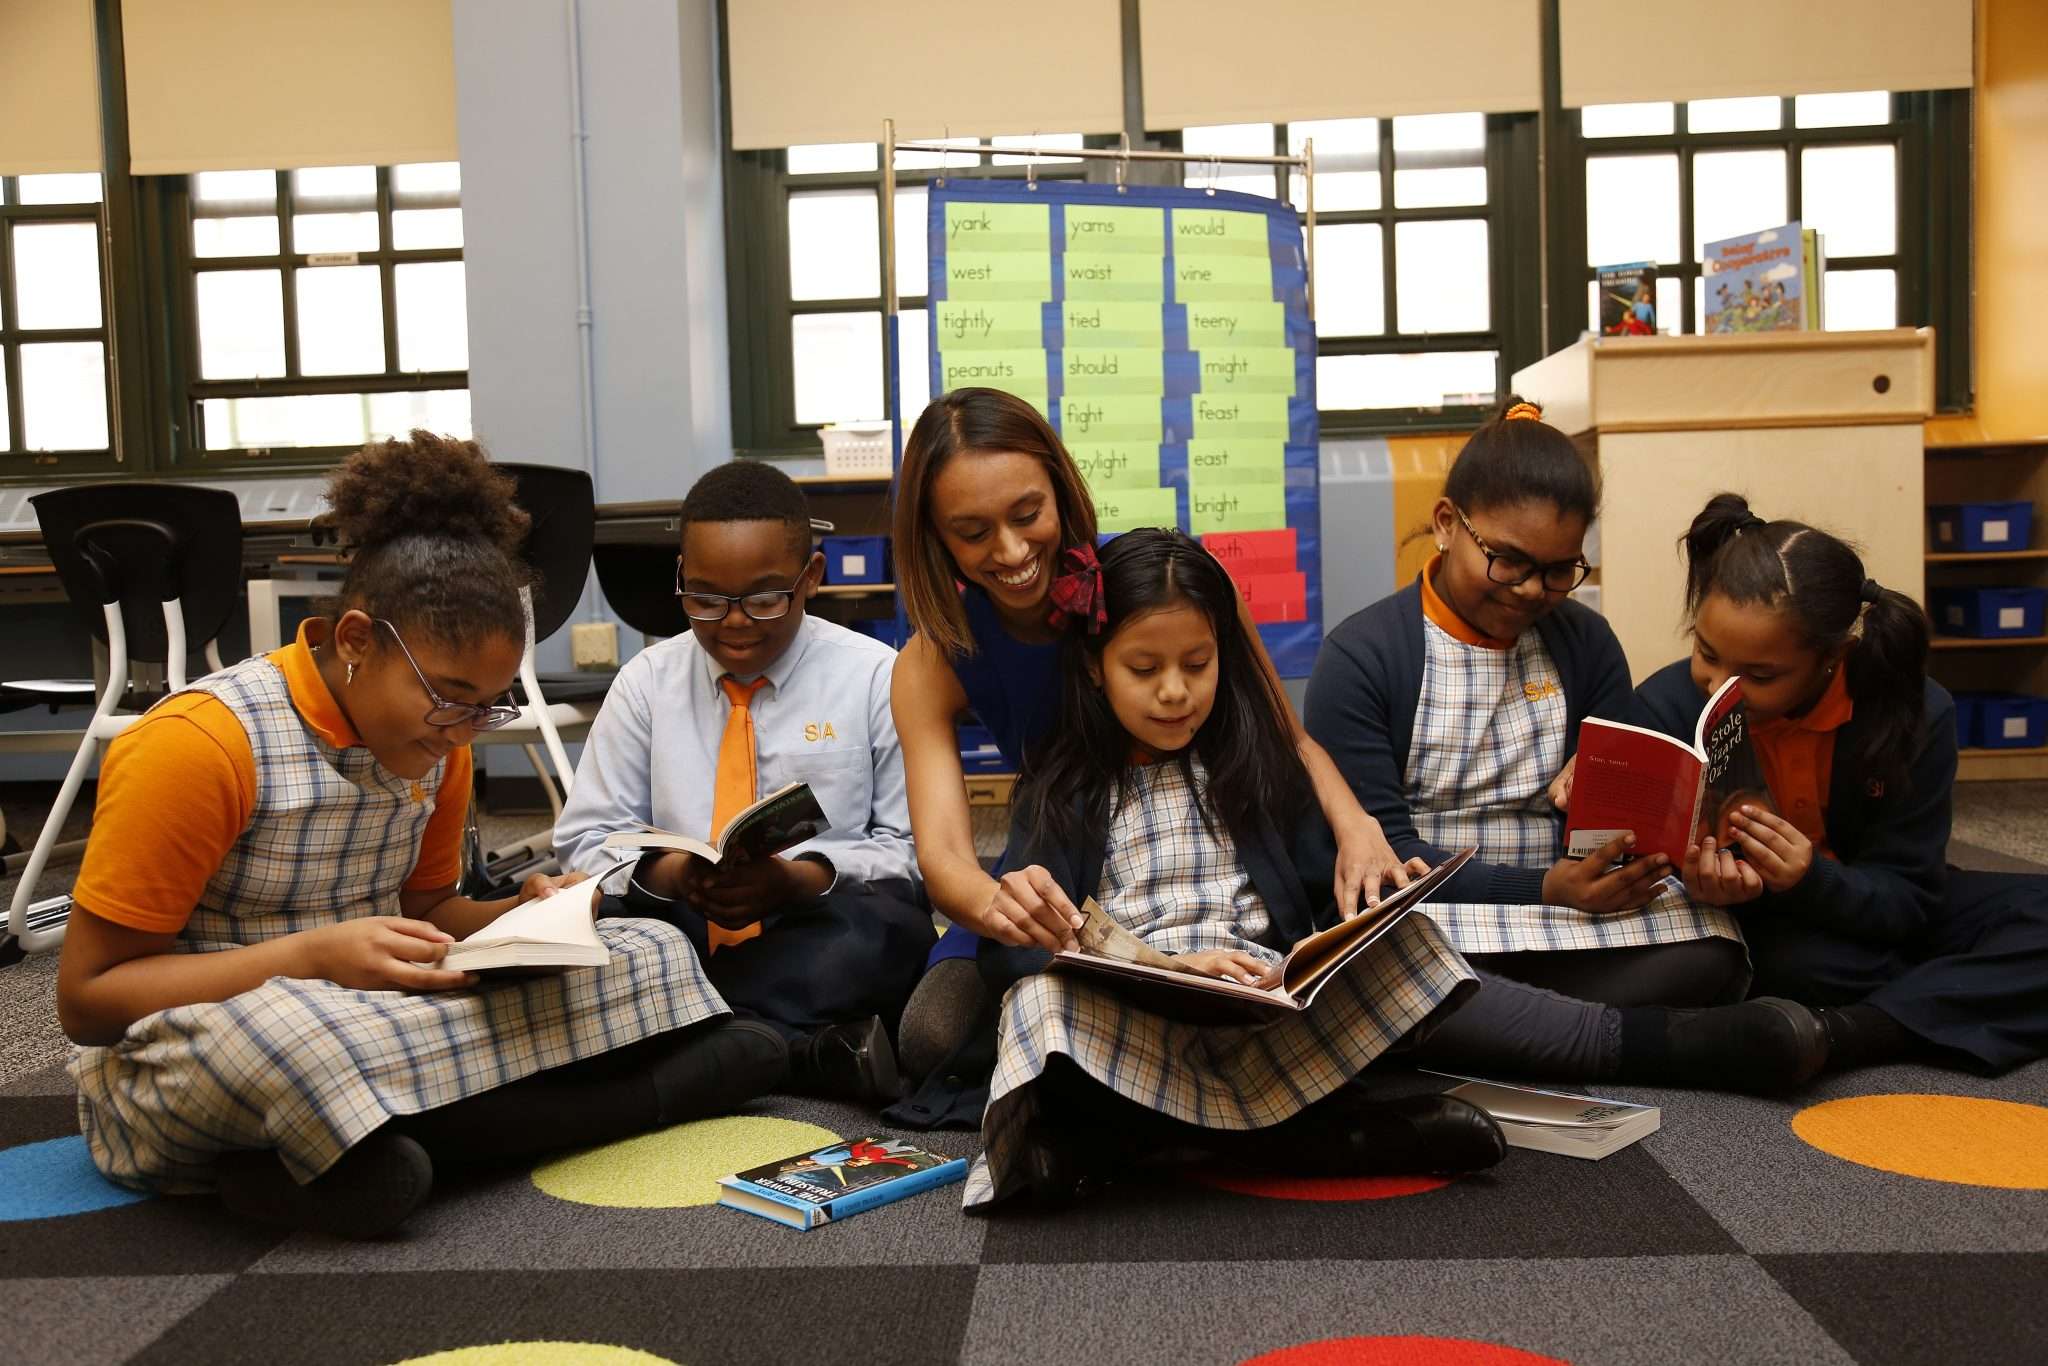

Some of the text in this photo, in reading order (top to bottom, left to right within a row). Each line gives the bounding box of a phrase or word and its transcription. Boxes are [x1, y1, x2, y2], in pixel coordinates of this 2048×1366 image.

[951, 215, 992, 240] yank
[1071, 221, 1115, 240] yams
[1178, 217, 1225, 237] would
[952, 264, 992, 281] west
[1070, 264, 1112, 281] waist
[1181, 266, 1212, 281] vine
[944, 311, 994, 339] tightly
[1070, 311, 1101, 329] tied
[1194, 314, 1238, 334] teeny
[948, 362, 1014, 388] peanuts
[1069, 355, 1119, 375] should
[1205, 357, 1249, 383] might
[1067, 402, 1104, 433] fight
[1198, 402, 1241, 421] feast
[1194, 449, 1230, 467] east
[1195, 495, 1240, 523] bright
[804, 722, 838, 742] SA
[1711, 713, 1742, 749] Stole
[1709, 755, 1729, 784] Oz?
[754, 1177, 825, 1204] THE TOWER
[776, 1176, 840, 1199] TREASURE
